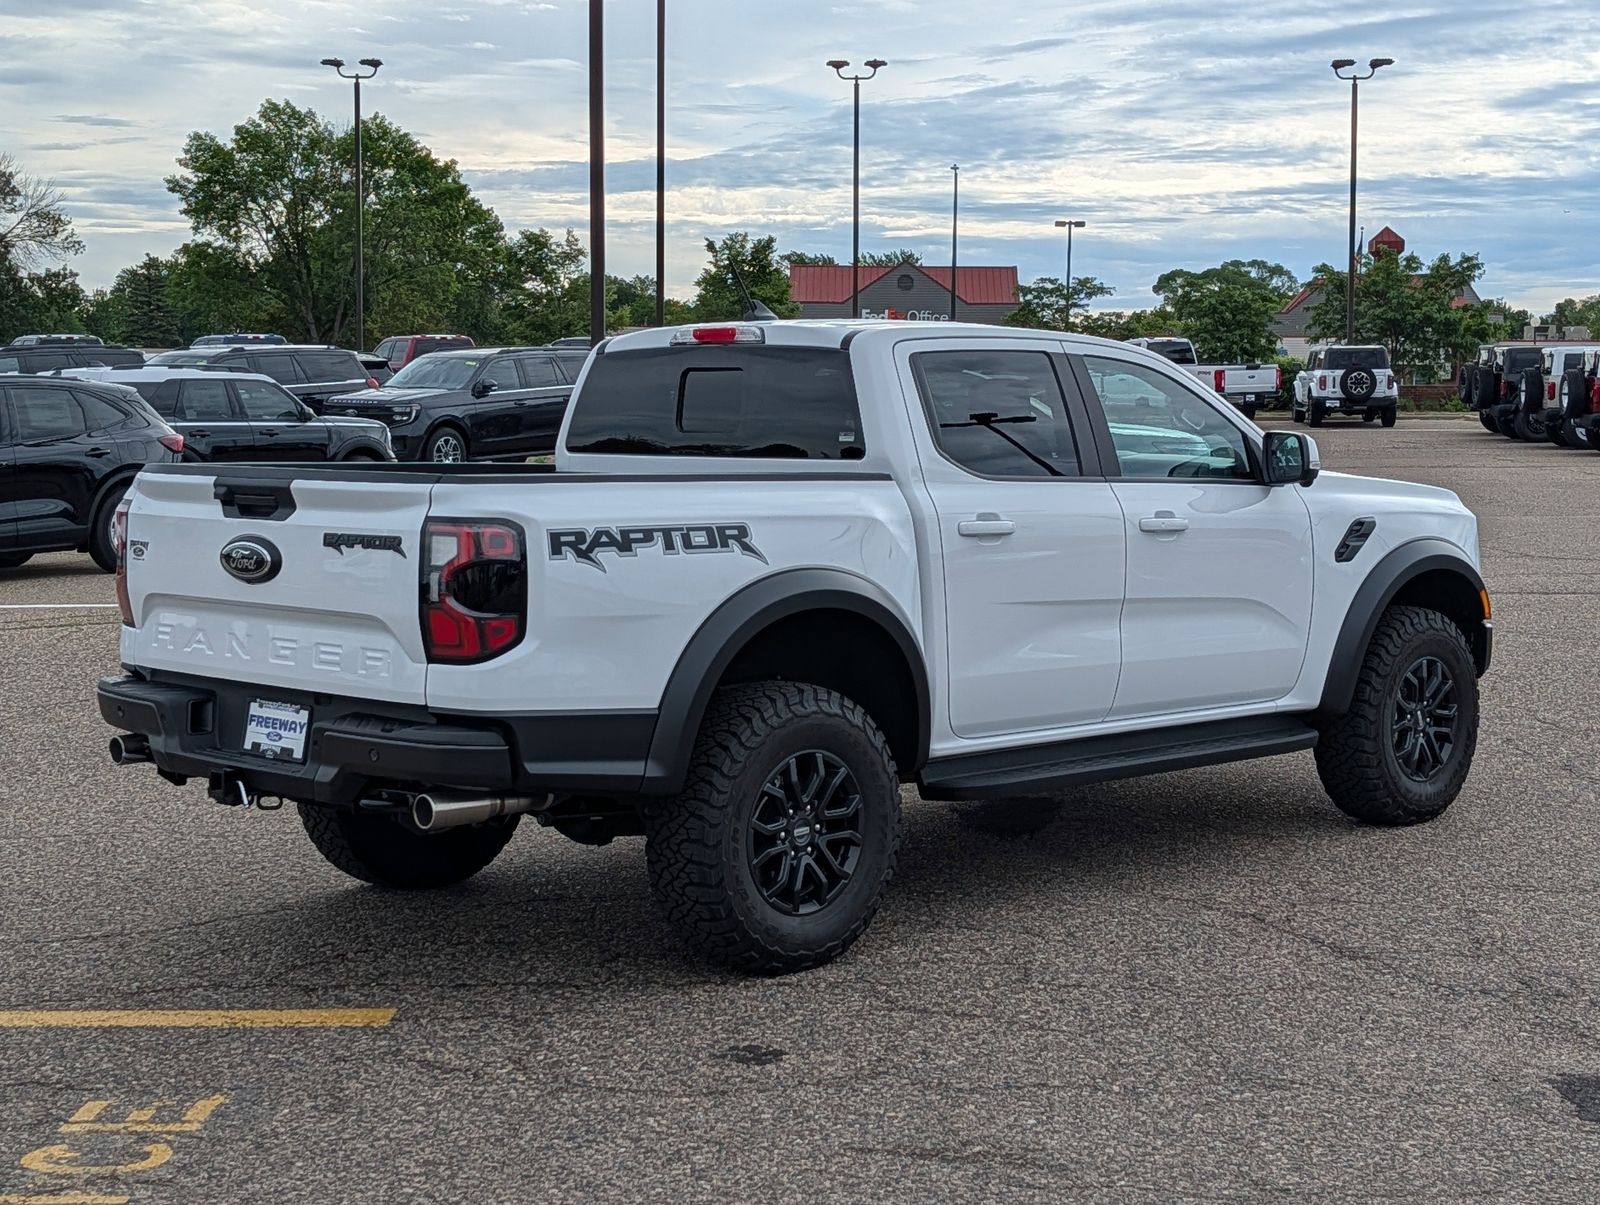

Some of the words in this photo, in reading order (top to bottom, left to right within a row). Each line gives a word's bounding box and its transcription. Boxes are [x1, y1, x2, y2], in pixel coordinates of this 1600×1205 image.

[907, 310, 949, 321] Office
[323, 533, 407, 559] RAPTOR
[546, 522, 770, 574] RAPTOR
[230, 548, 257, 570] Ford
[151, 622, 393, 678] RANGER
[248, 714, 306, 734] FREEWAY
